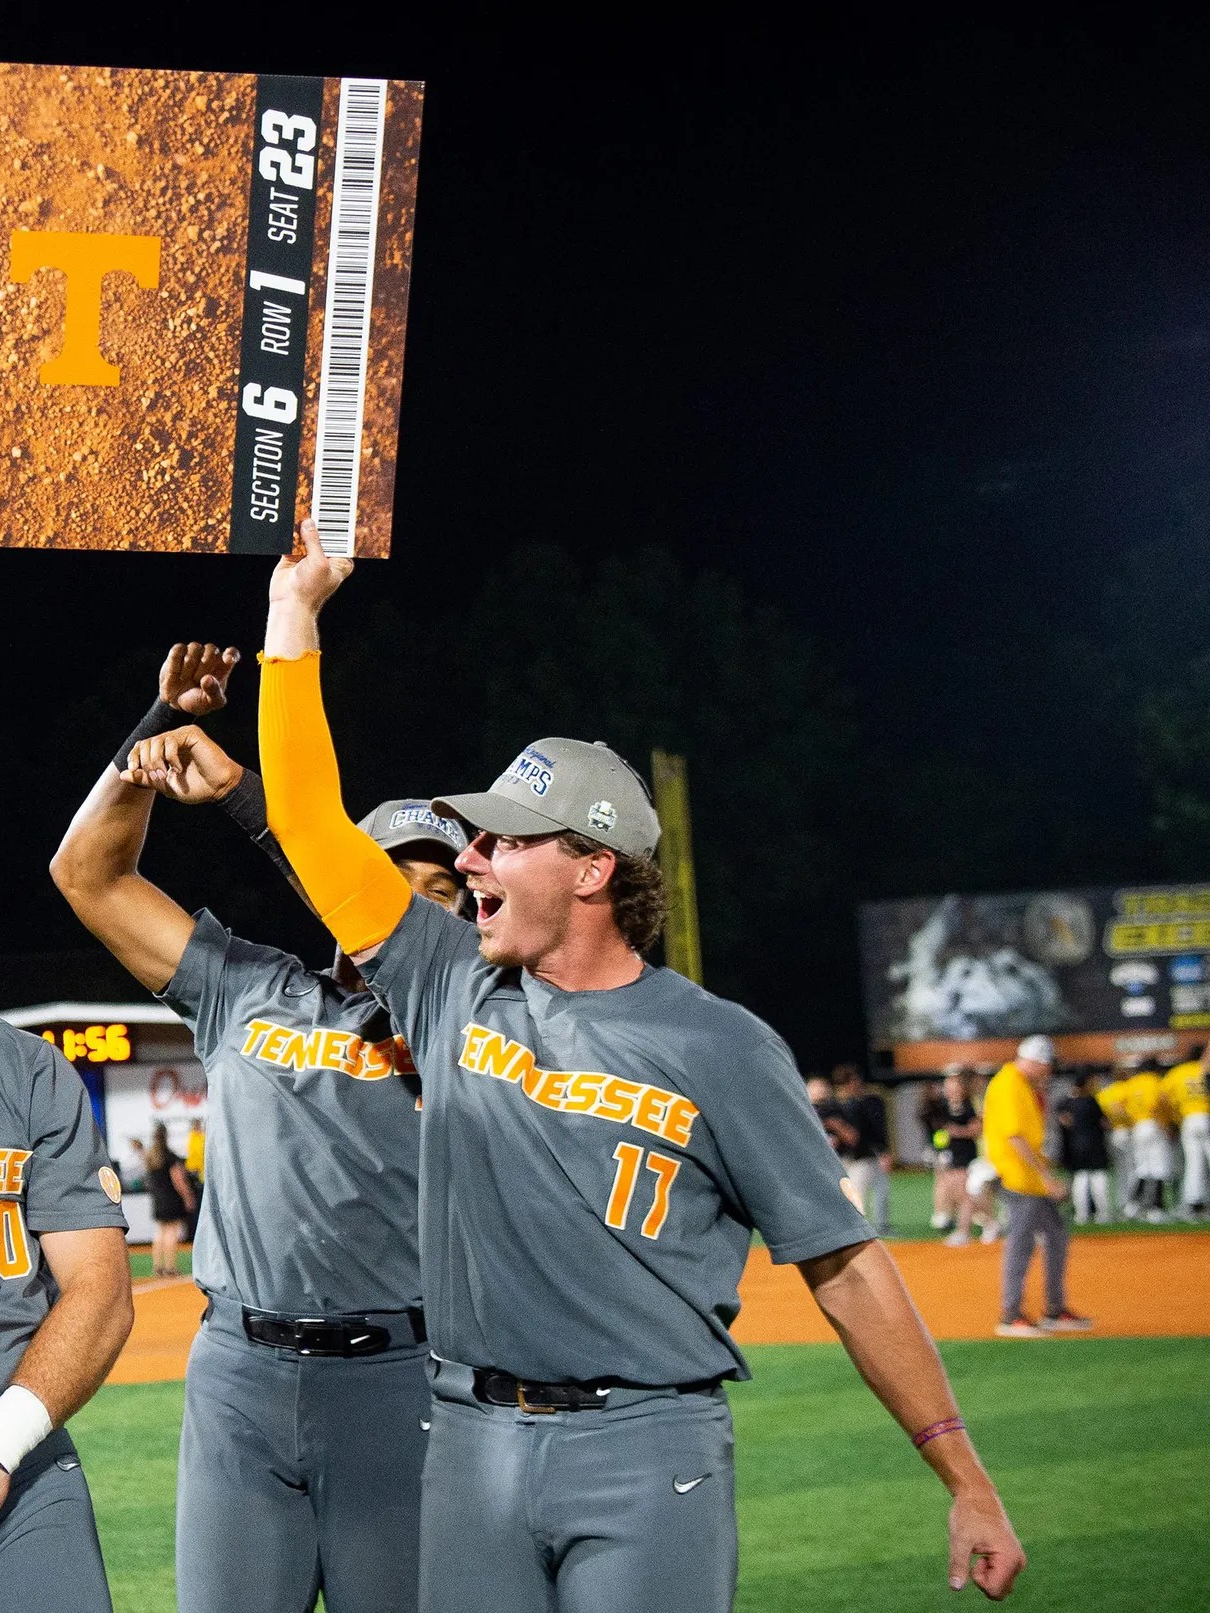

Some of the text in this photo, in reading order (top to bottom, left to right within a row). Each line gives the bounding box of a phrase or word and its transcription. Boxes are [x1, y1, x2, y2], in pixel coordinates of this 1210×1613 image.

[10, 230, 162, 386] T
[242, 108, 317, 524] SECTION 6 ROW 1 SEAT 23
[389, 810, 460, 848] CHAM
[42, 1024, 131, 1062] 1:56
[458, 1022, 700, 1148] ENNESSEE
[605, 1141, 682, 1240] 17
